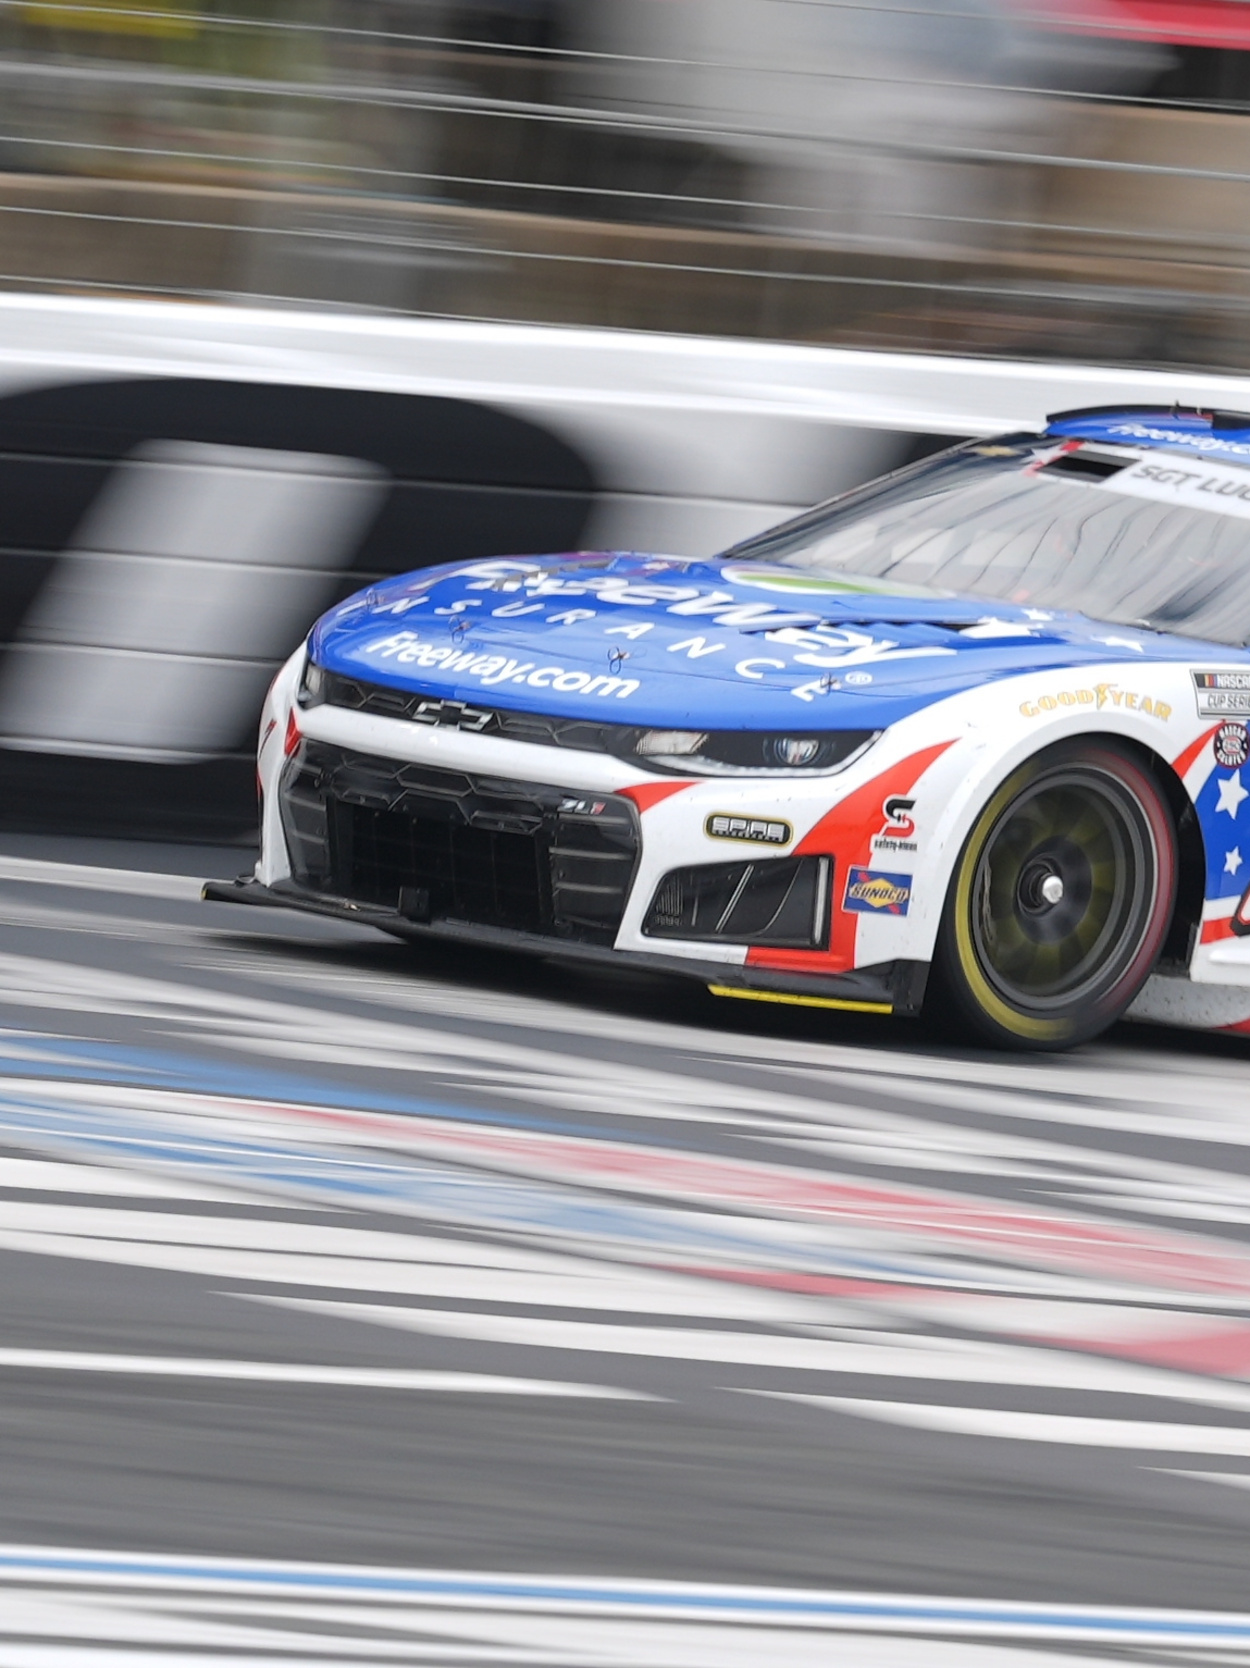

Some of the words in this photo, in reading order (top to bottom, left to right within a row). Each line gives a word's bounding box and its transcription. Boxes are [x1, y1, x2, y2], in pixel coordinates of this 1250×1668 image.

[1132, 464, 1199, 486] SGT
[365, 630, 641, 699] Freeway.com
[1019, 683, 1173, 723] GOODYEAR
[1207, 692, 1226, 708] CUP
[850, 883, 910, 904] SUNOCO
